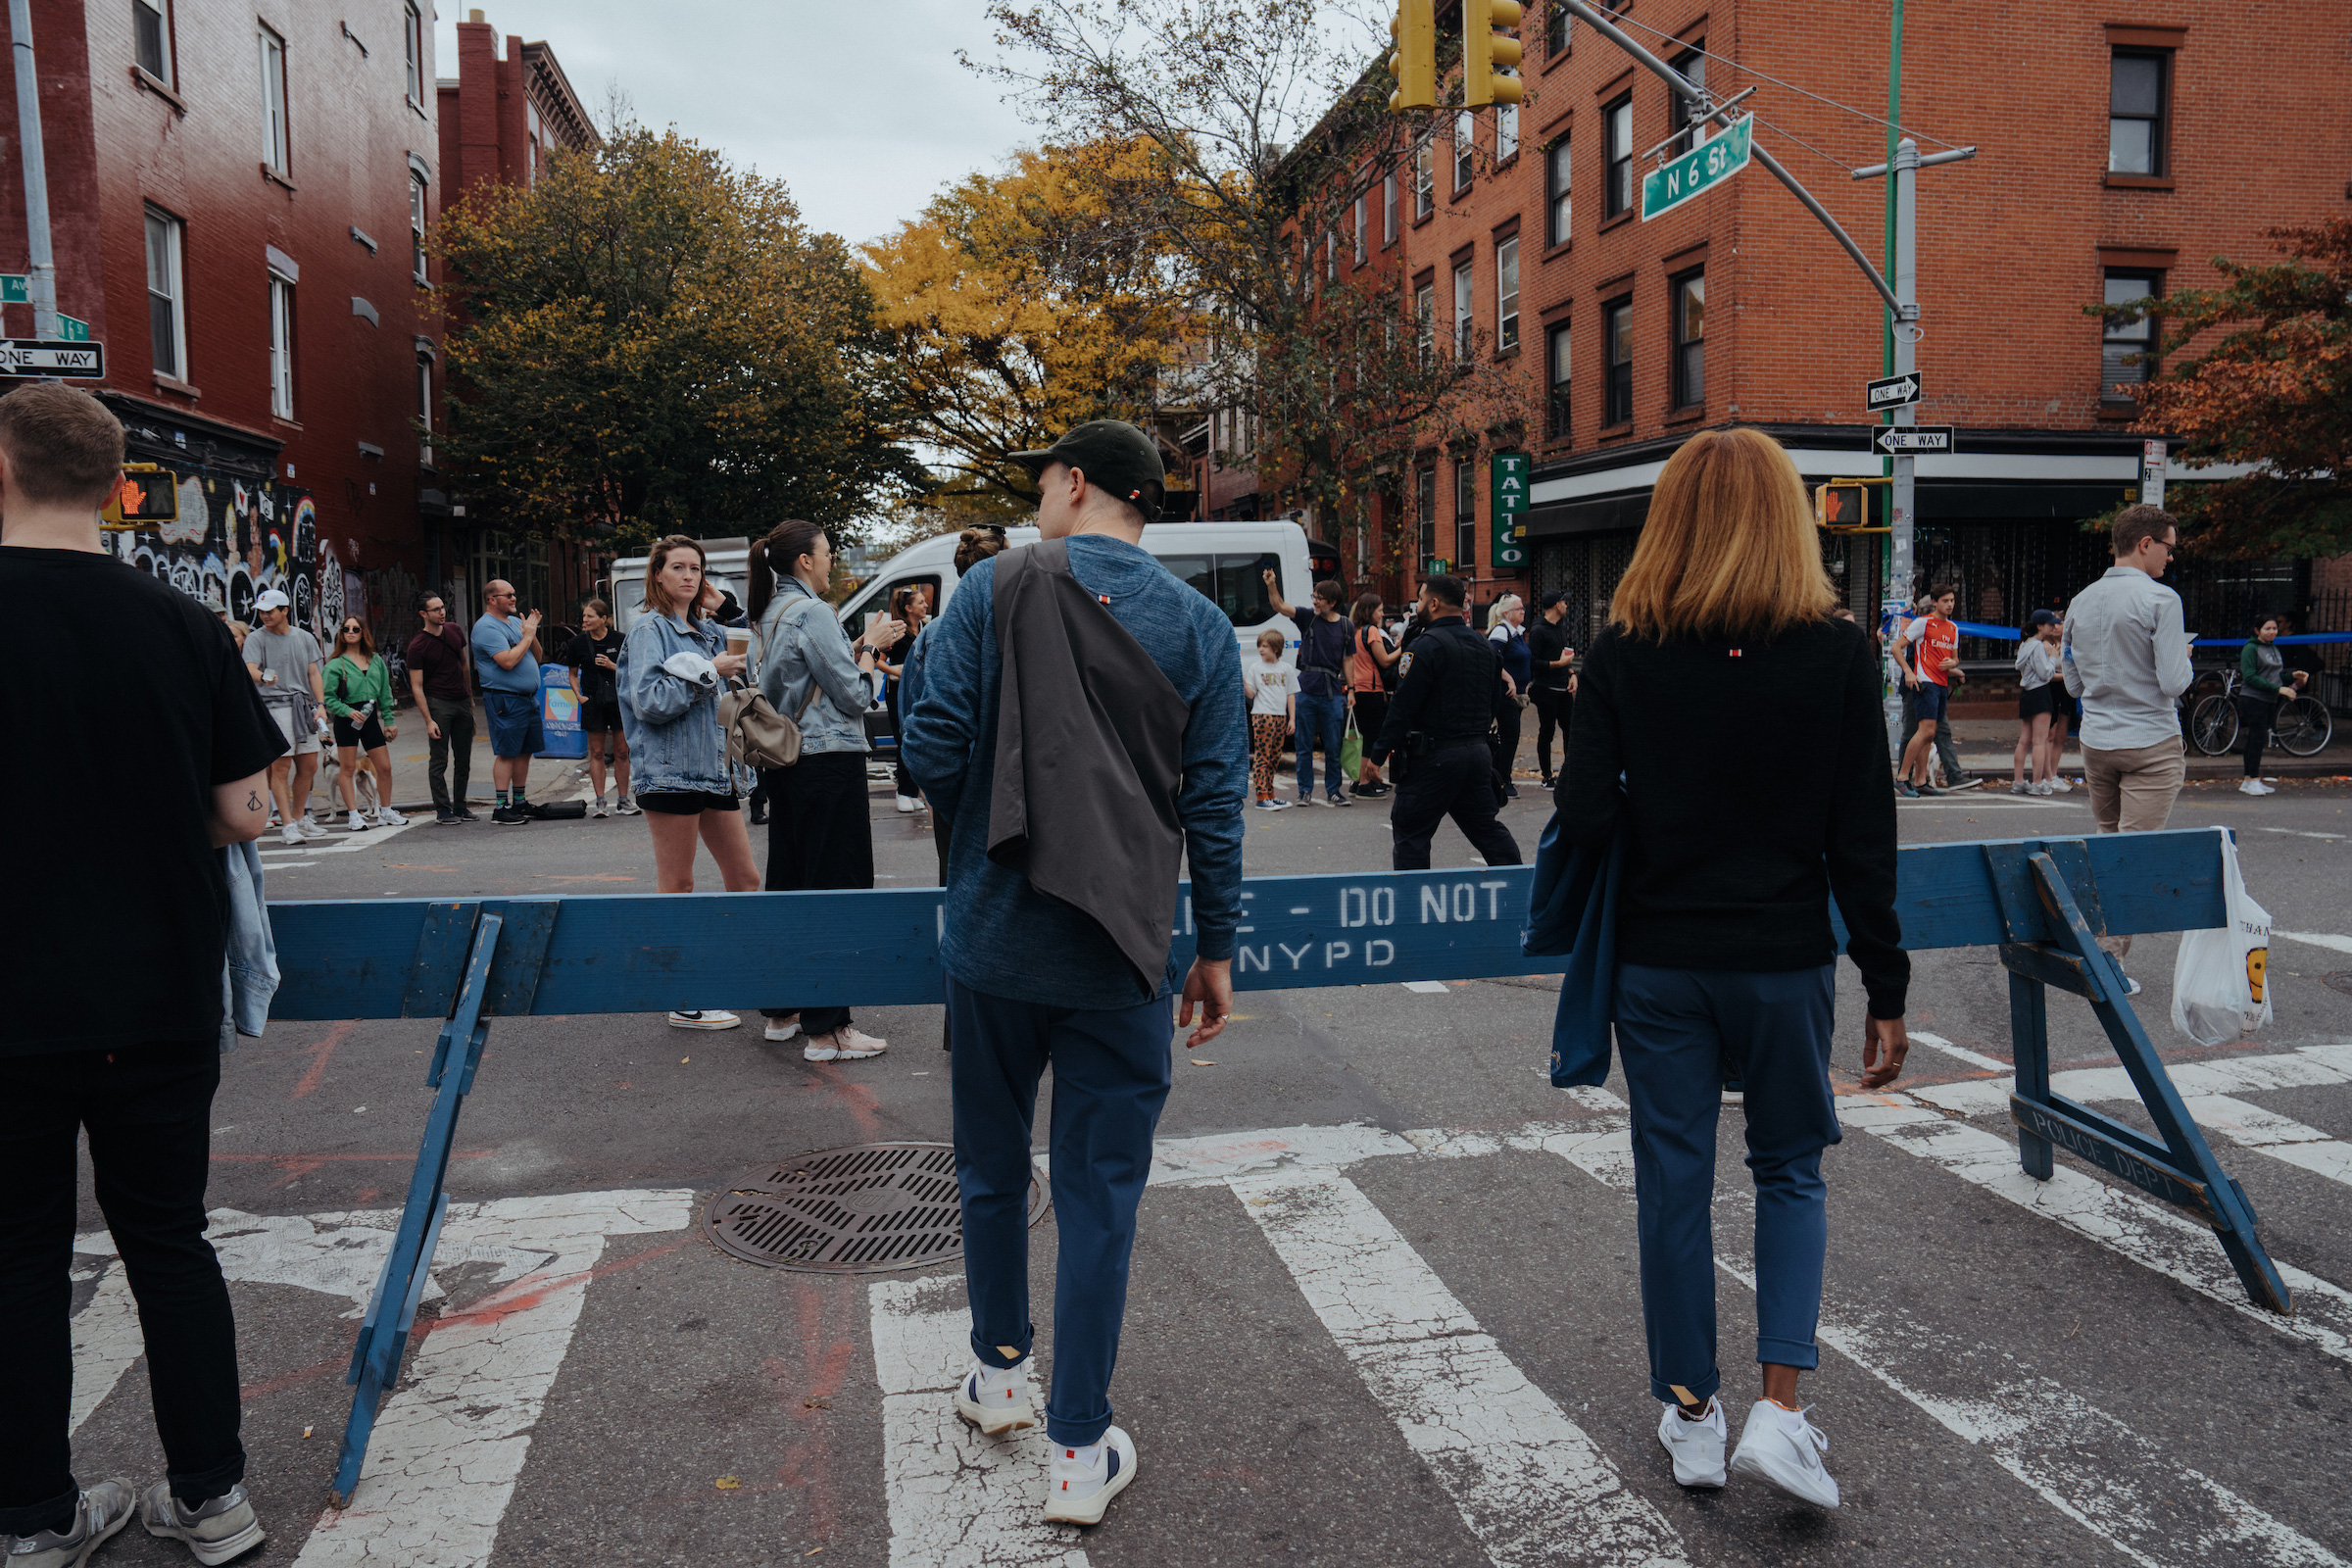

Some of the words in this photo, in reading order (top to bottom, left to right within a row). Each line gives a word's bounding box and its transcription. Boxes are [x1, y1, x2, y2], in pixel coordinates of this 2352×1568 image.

[1667, 168, 1680, 200] N
[1688, 158, 1699, 187] 6
[1707, 141, 1727, 176] St
[68, 320, 75, 341] 6
[76, 323, 84, 335] St
[55, 352, 92, 367] WAY
[1874, 387, 1890, 401] ONE
[1896, 382, 1913, 397] WAY
[1885, 434, 1907, 447] ONE
[1918, 434, 1942, 447] WAY
[549, 699, 576, 710] family
[1340, 886, 1396, 928] DO
[1421, 881, 1508, 924] NOT
[1238, 939, 1396, 973] NYPD
[2032, 1110, 2106, 1165] POLICE
[2114, 1150, 2173, 1200] DEPT
